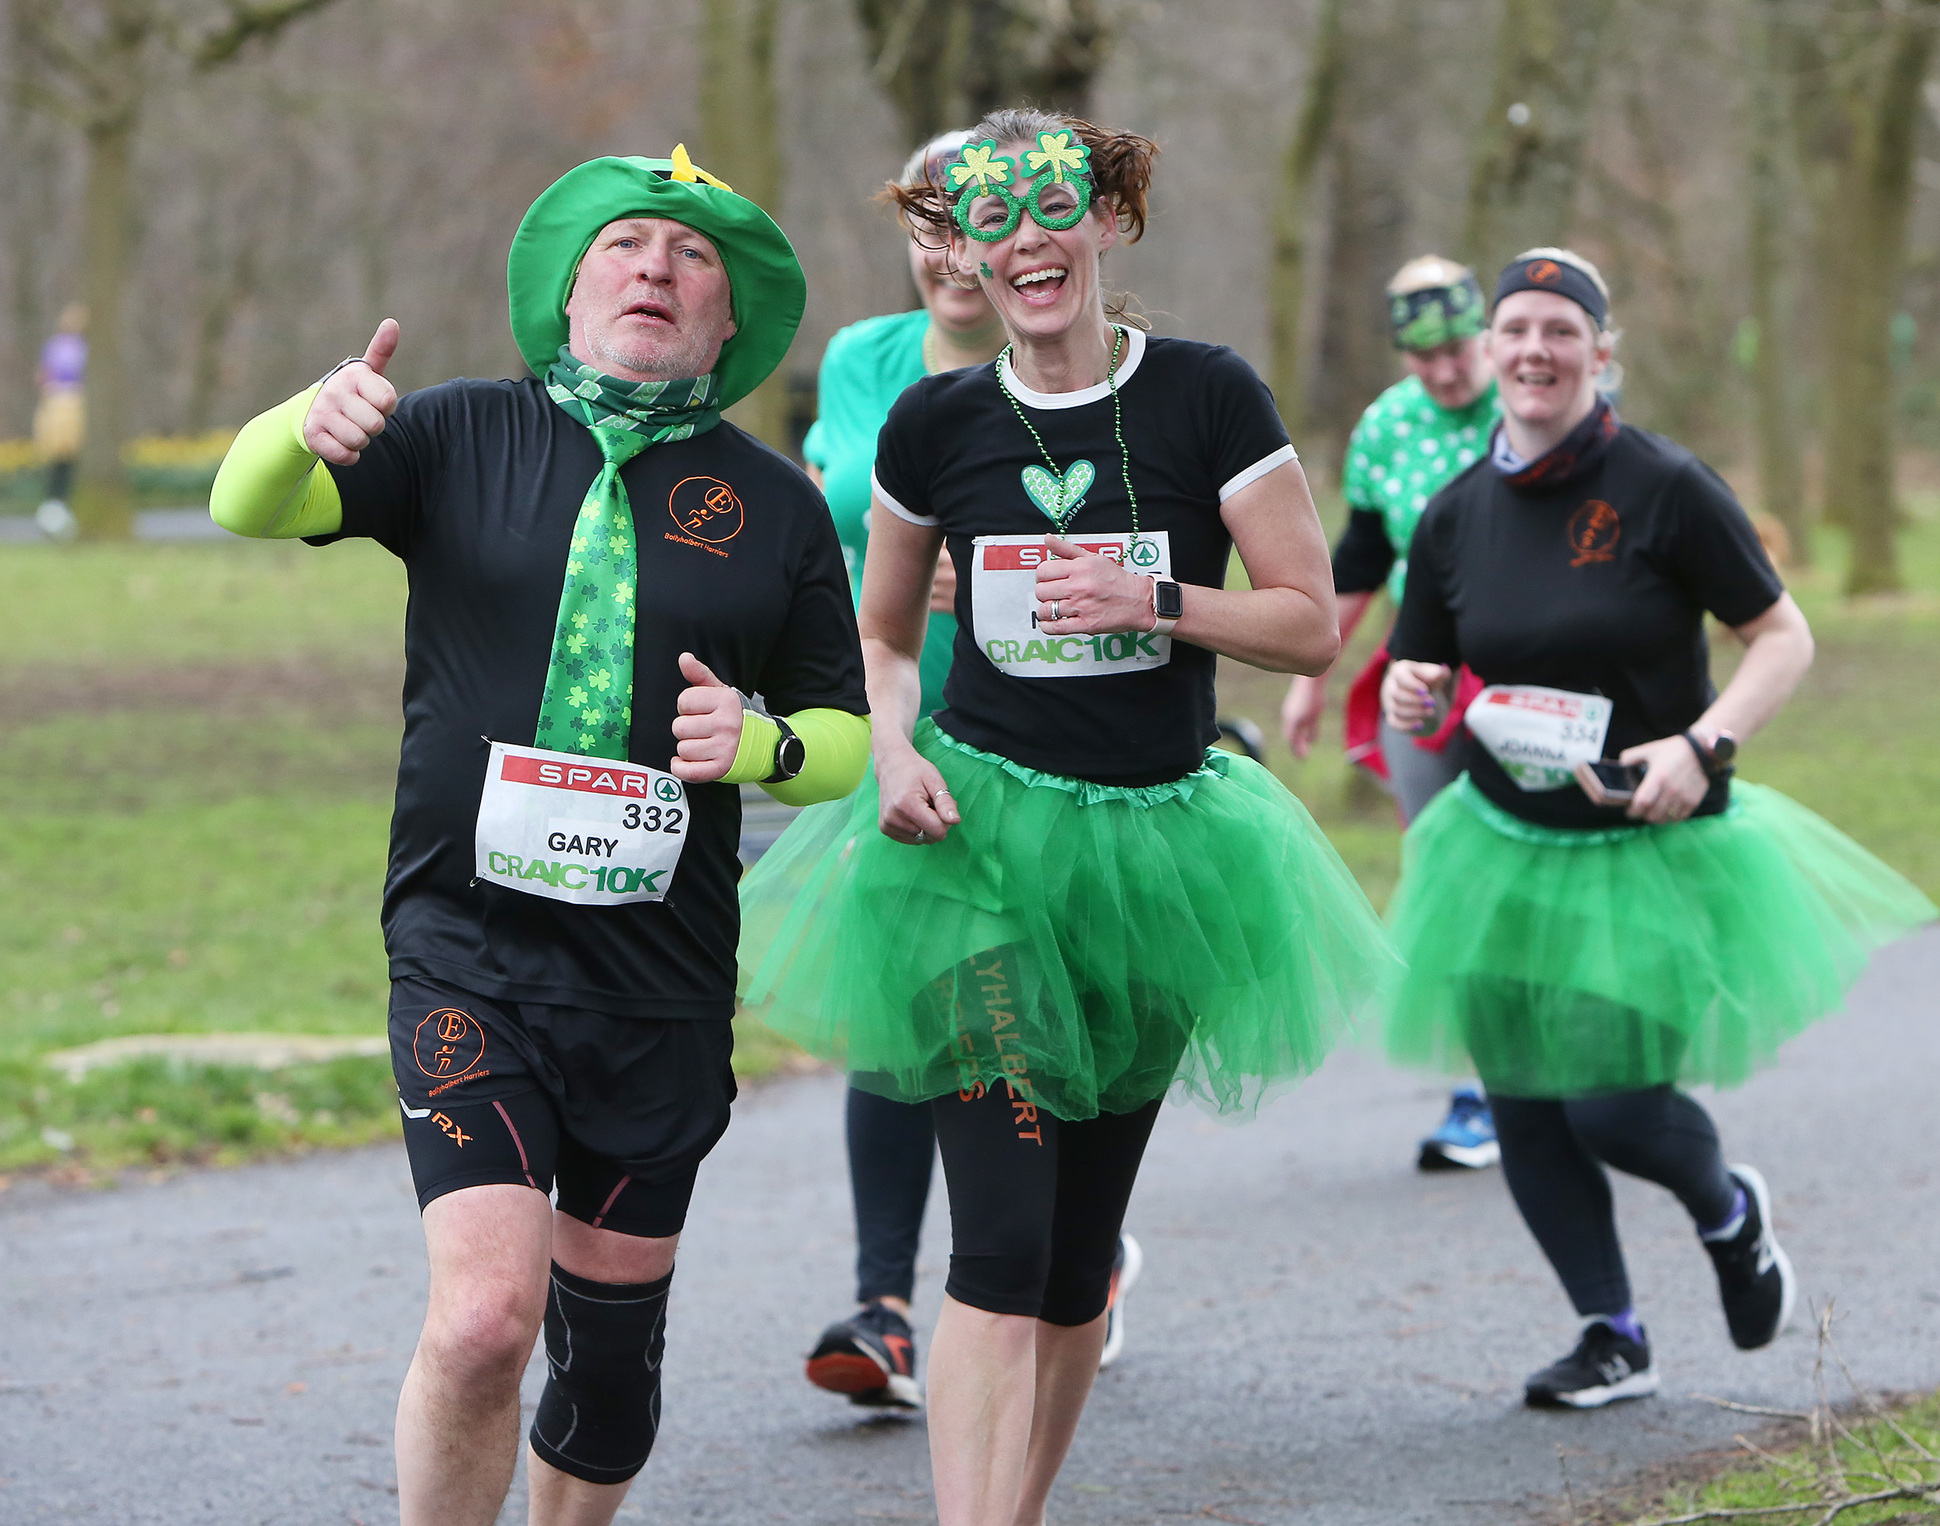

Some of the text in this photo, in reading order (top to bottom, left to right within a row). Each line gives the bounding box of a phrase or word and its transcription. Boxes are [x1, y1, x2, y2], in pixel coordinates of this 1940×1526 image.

[1018, 546, 1122, 566] SR
[538, 764, 646, 795] SPAR
[622, 803, 683, 834] 332
[548, 832, 619, 858] GARY
